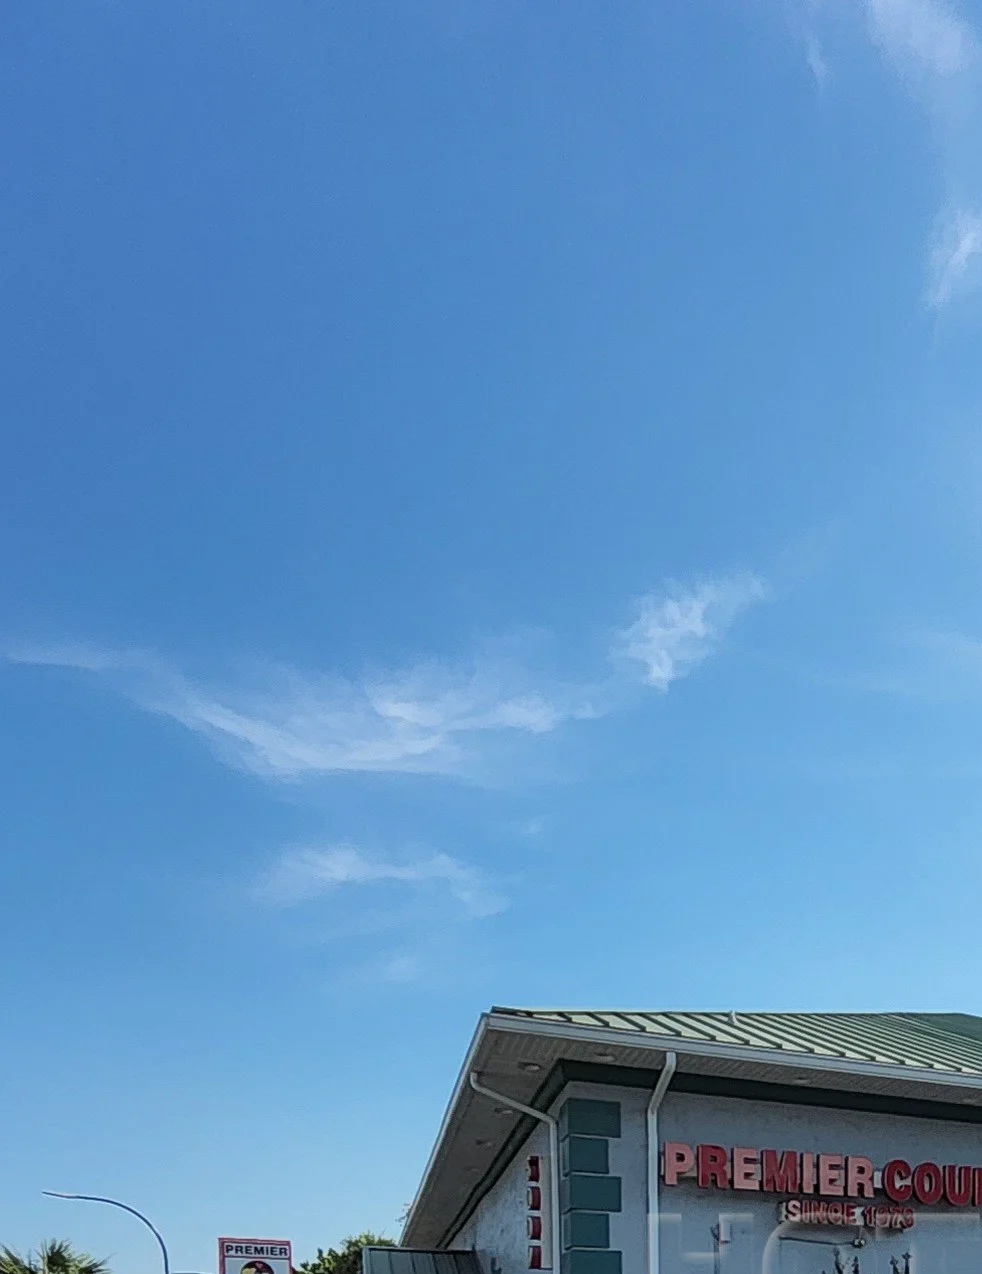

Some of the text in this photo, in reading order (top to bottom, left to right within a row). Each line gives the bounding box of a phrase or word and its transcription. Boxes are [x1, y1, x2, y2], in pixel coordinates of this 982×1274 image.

[661, 1140, 876, 1199] PREMIER
[785, 1200, 861, 1227] SINCE
[225, 1244, 288, 1257] PREMIER
